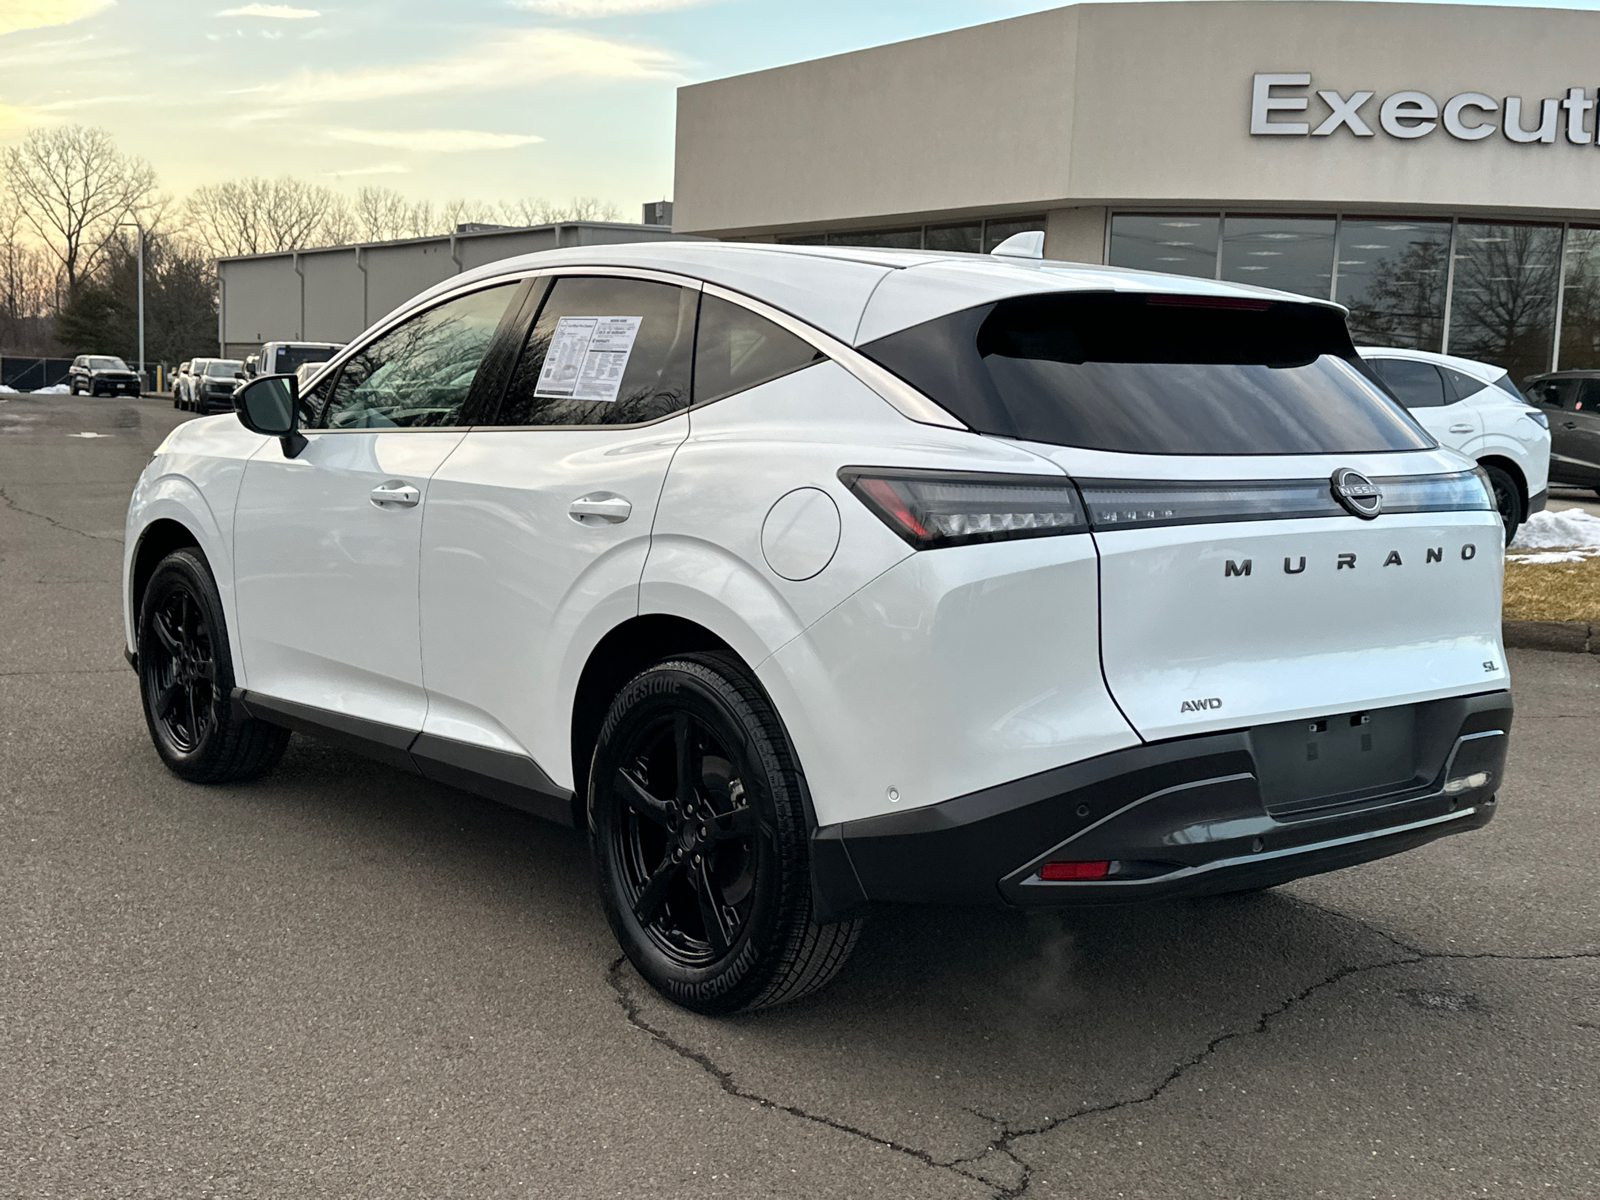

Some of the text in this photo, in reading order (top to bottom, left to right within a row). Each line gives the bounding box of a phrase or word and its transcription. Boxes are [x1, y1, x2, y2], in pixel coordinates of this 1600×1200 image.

[1249, 71, 1600, 147] Execut
[1224, 543, 1477, 577] MURANO
[1482, 660, 1499, 673] SL
[600, 675, 681, 746] BRIDGESTONE
[1180, 697, 1222, 713] AWD
